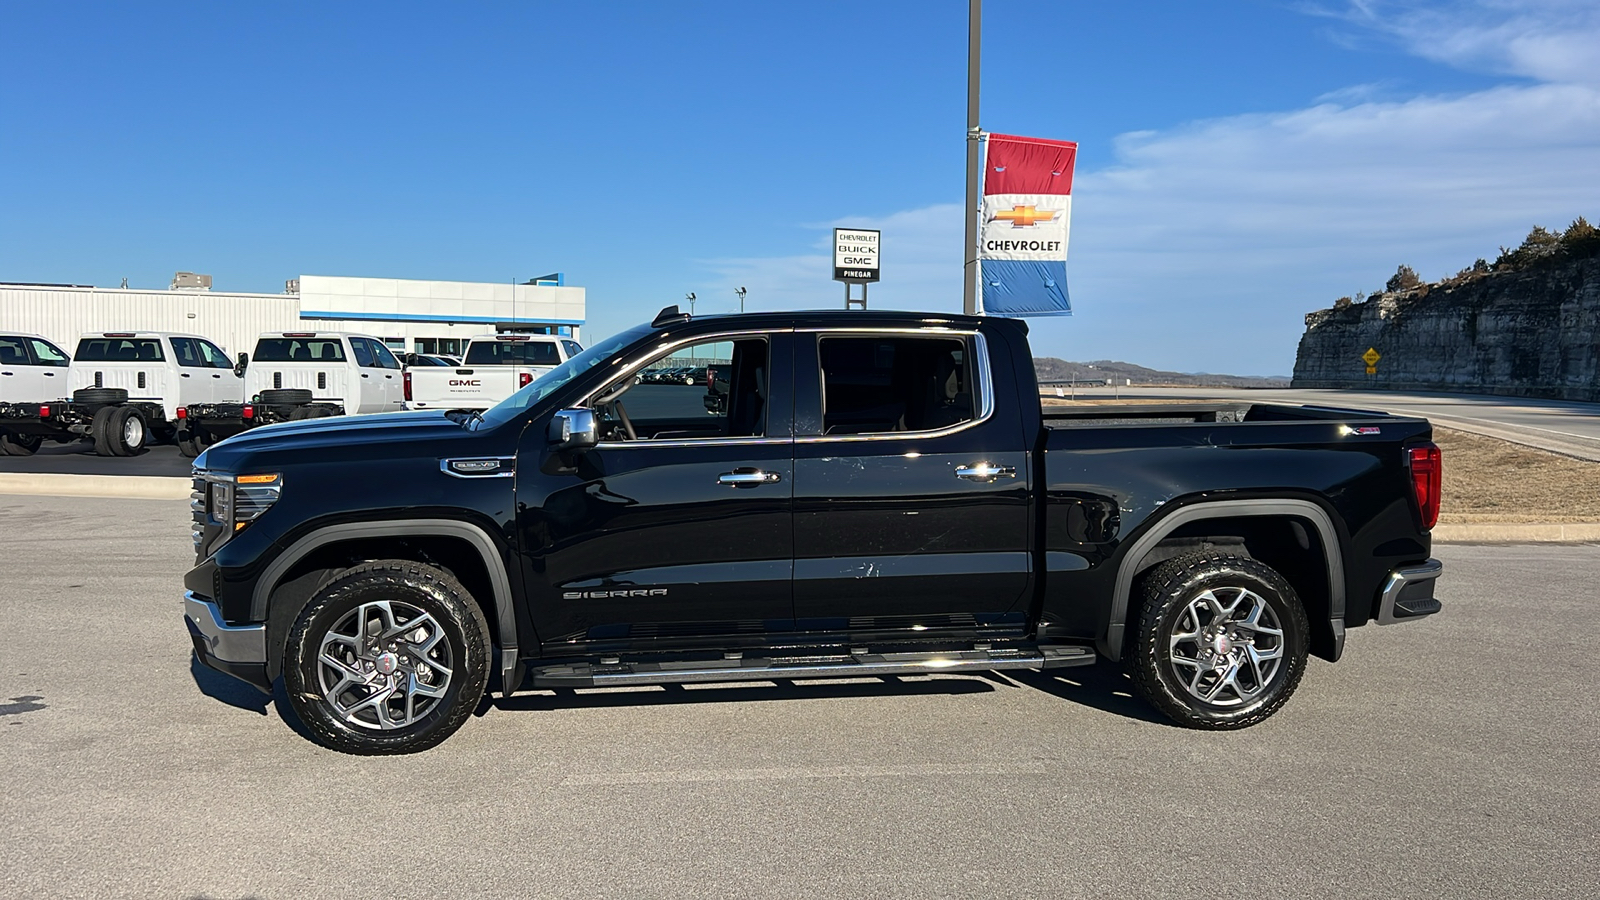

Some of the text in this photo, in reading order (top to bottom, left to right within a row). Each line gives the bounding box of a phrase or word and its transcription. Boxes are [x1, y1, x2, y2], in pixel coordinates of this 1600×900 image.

[839, 234, 877, 242] CHEVROLET
[838, 245, 876, 254] BUICK
[987, 240, 1061, 251] CHEVROLET
[843, 257, 872, 265] GMC
[843, 270, 872, 278] PINEGAR
[563, 588, 668, 600] SIERRA
